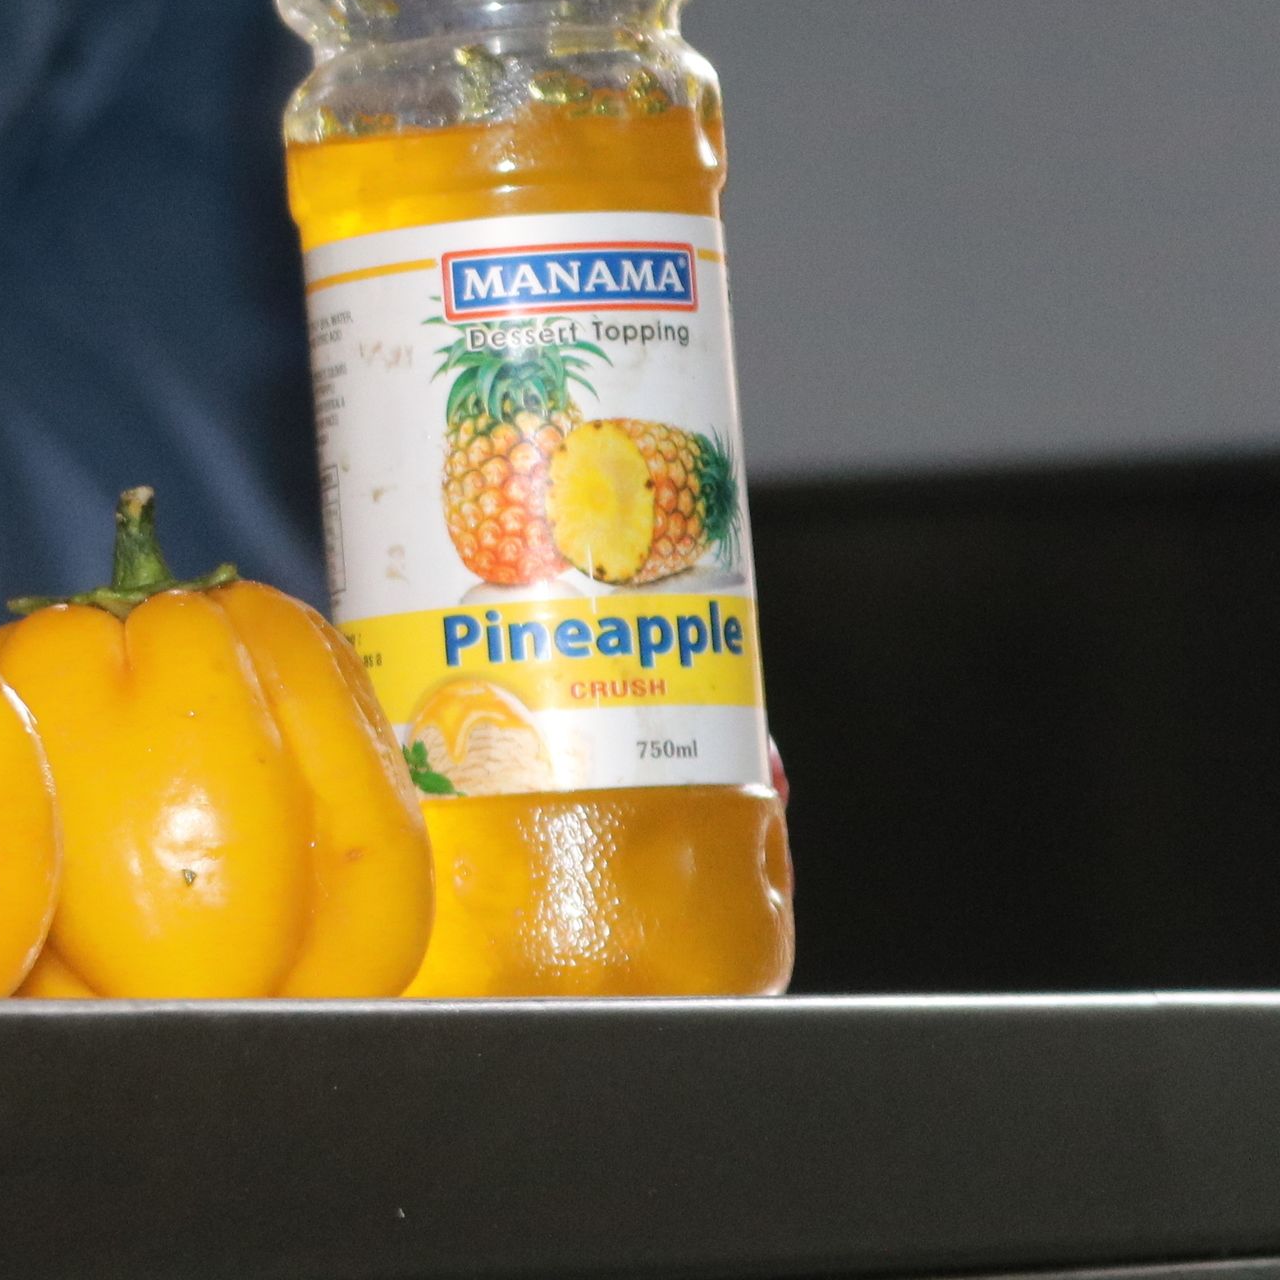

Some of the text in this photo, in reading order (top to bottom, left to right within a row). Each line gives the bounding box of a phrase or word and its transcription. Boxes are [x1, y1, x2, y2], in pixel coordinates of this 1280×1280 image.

[462, 260, 684, 300] MANAMA
[470, 320, 690, 349] Dessert Topping
[443, 601, 744, 668] Pineapple
[570, 679, 667, 699] CRUSH
[636, 739, 698, 759] 750ml
